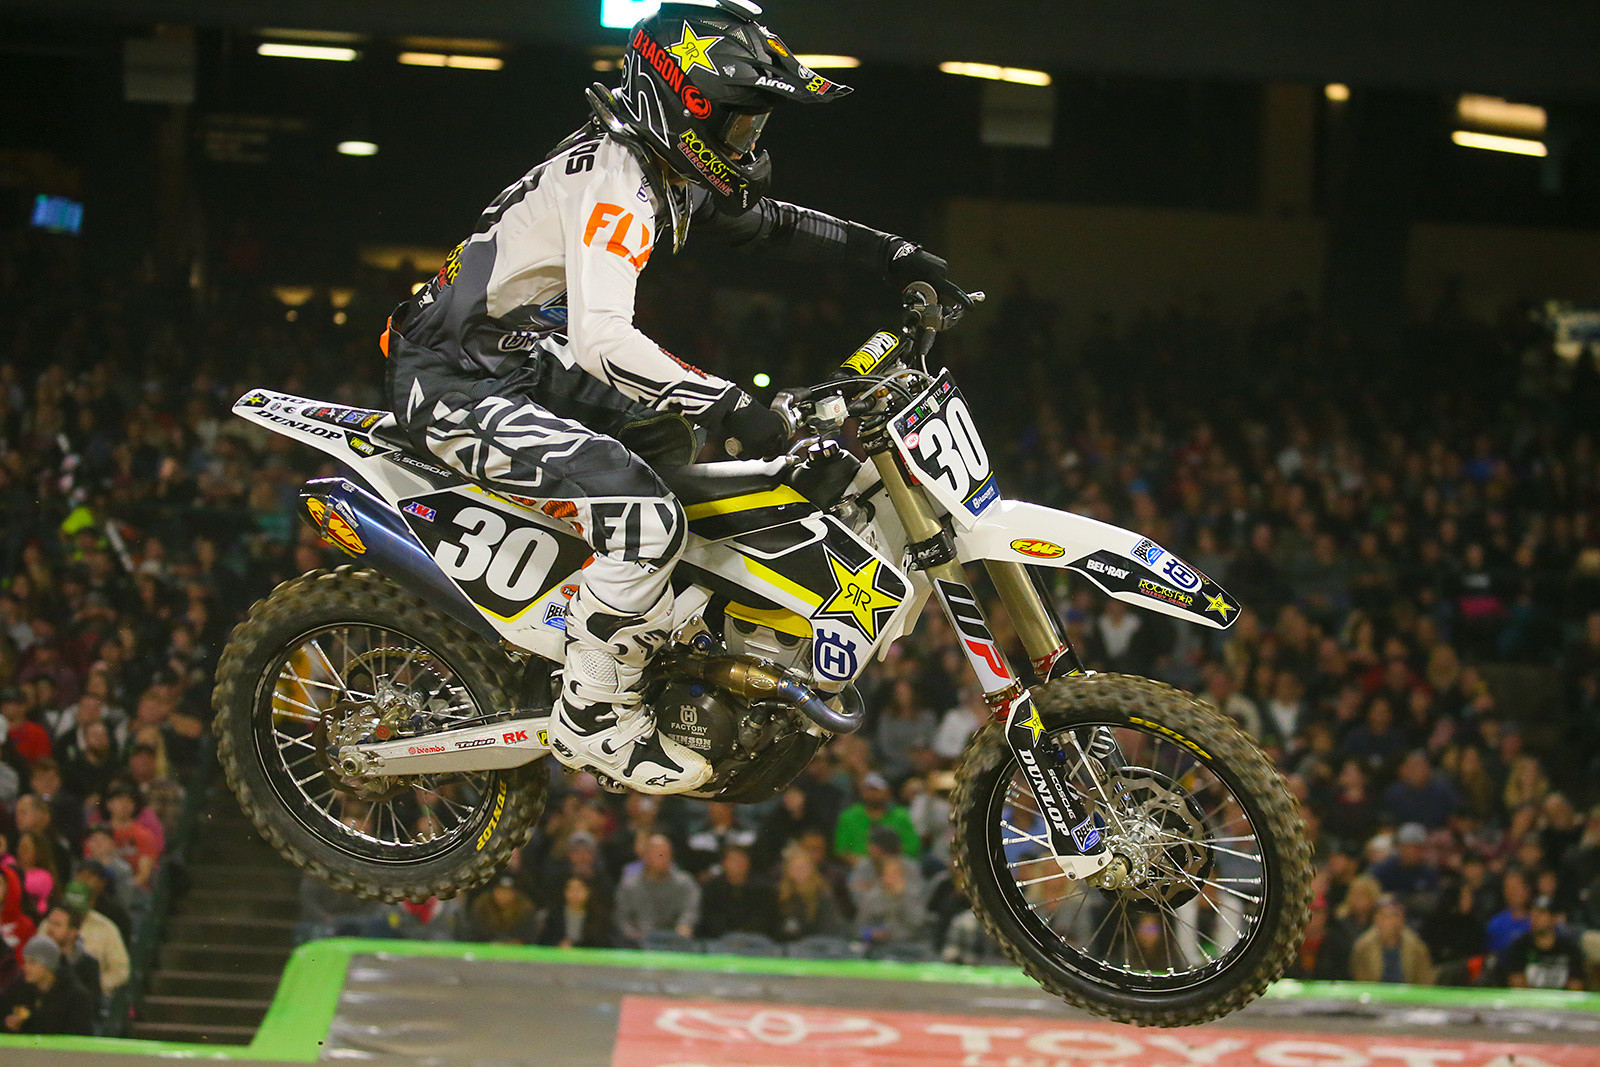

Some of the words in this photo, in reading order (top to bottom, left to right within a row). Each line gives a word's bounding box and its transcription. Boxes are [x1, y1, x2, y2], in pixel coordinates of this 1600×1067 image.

[632, 29, 685, 94] DRAGON
[679, 142, 710, 173] ENERGY
[708, 174, 733, 196] DRINK
[254, 409, 343, 441] DUNLOP
[918, 396, 990, 502] 30
[405, 501, 436, 521] AMA
[434, 506, 559, 602] 30
[1010, 539, 1066, 557] FMF
[416, 745, 446, 754] brembo
[502, 730, 529, 744] RK
[671, 722, 708, 733] FACTORY
[476, 779, 507, 851] DUNLOP
[1018, 749, 1071, 837] DUNLOP
